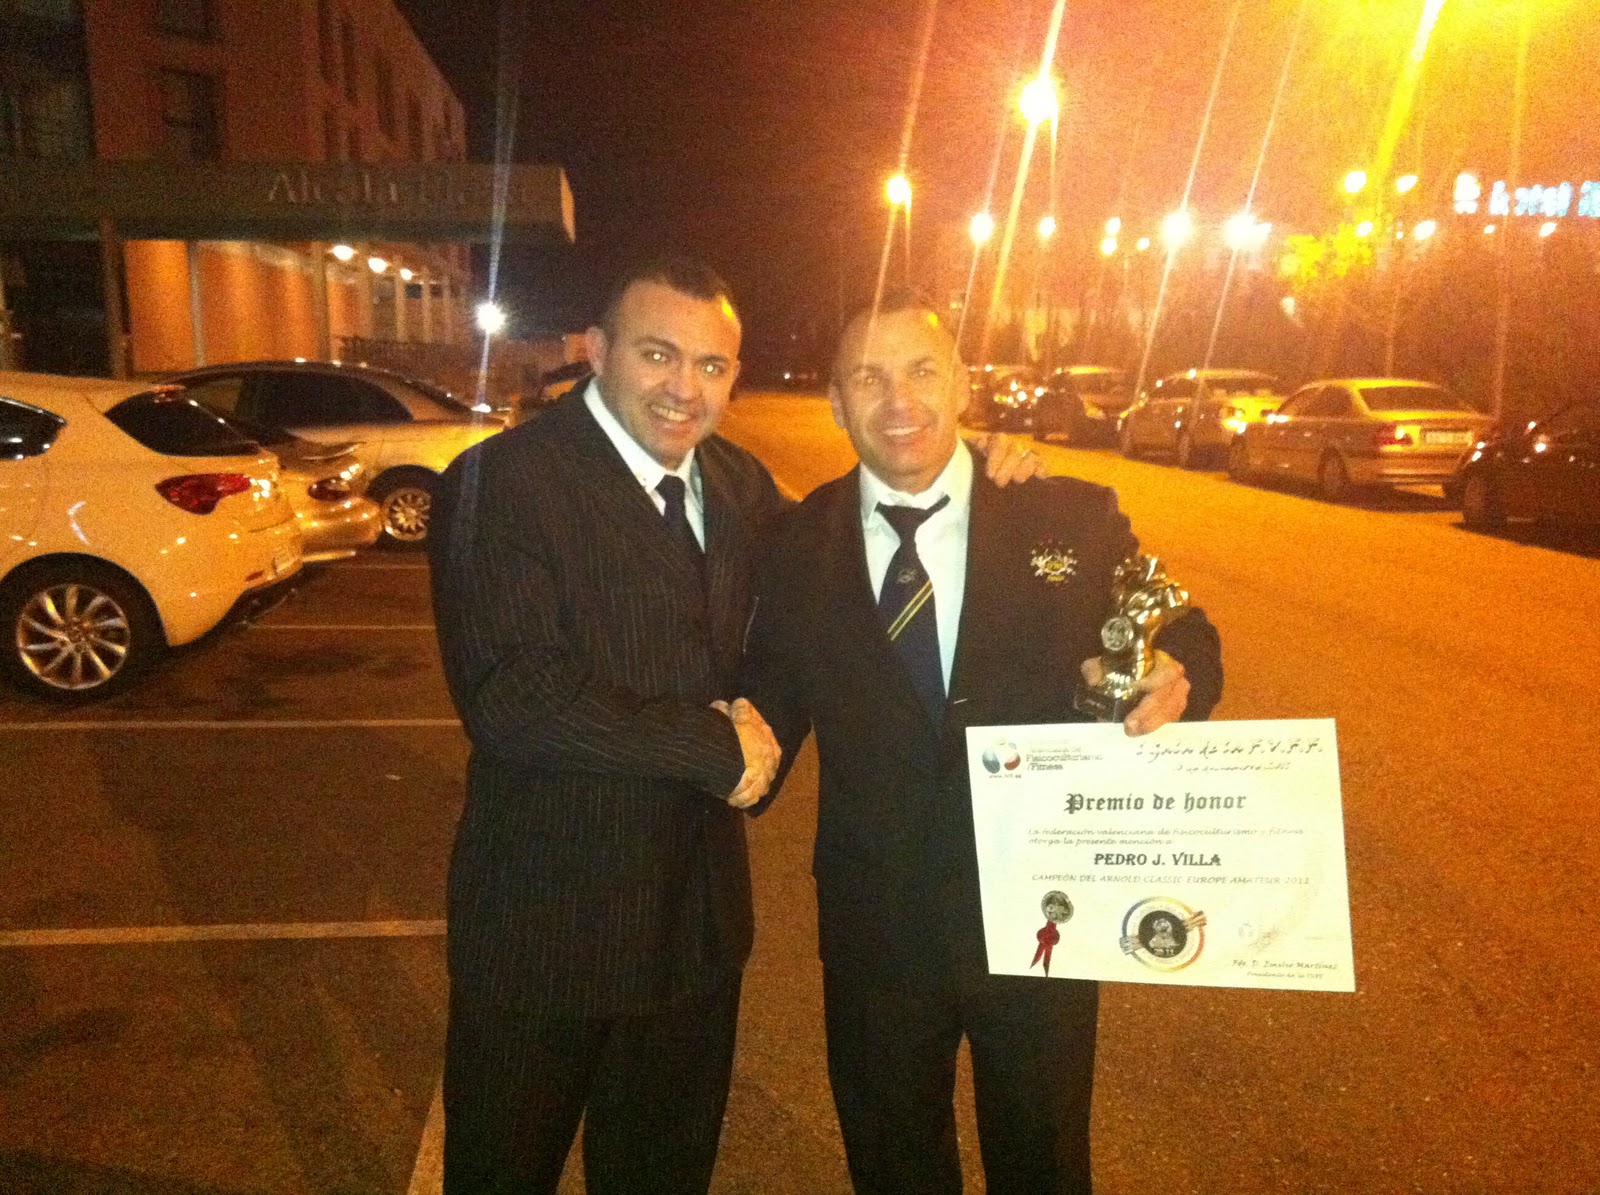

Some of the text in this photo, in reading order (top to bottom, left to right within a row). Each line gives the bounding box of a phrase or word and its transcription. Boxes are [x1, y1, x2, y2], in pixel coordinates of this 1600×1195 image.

[1064, 792, 1247, 814] Premio de honor
[1157, 827, 1171, 836] de
[1063, 837, 1075, 845] la
[1075, 838, 1118, 848] presente
[1093, 851, 1222, 867] PEDRO J. VILLA
[1079, 874, 1096, 883] DEL
[1099, 875, 1141, 884] ARNOLD
[1143, 875, 1184, 884] CLASSIC
[1186, 876, 1227, 885] EUROPE
